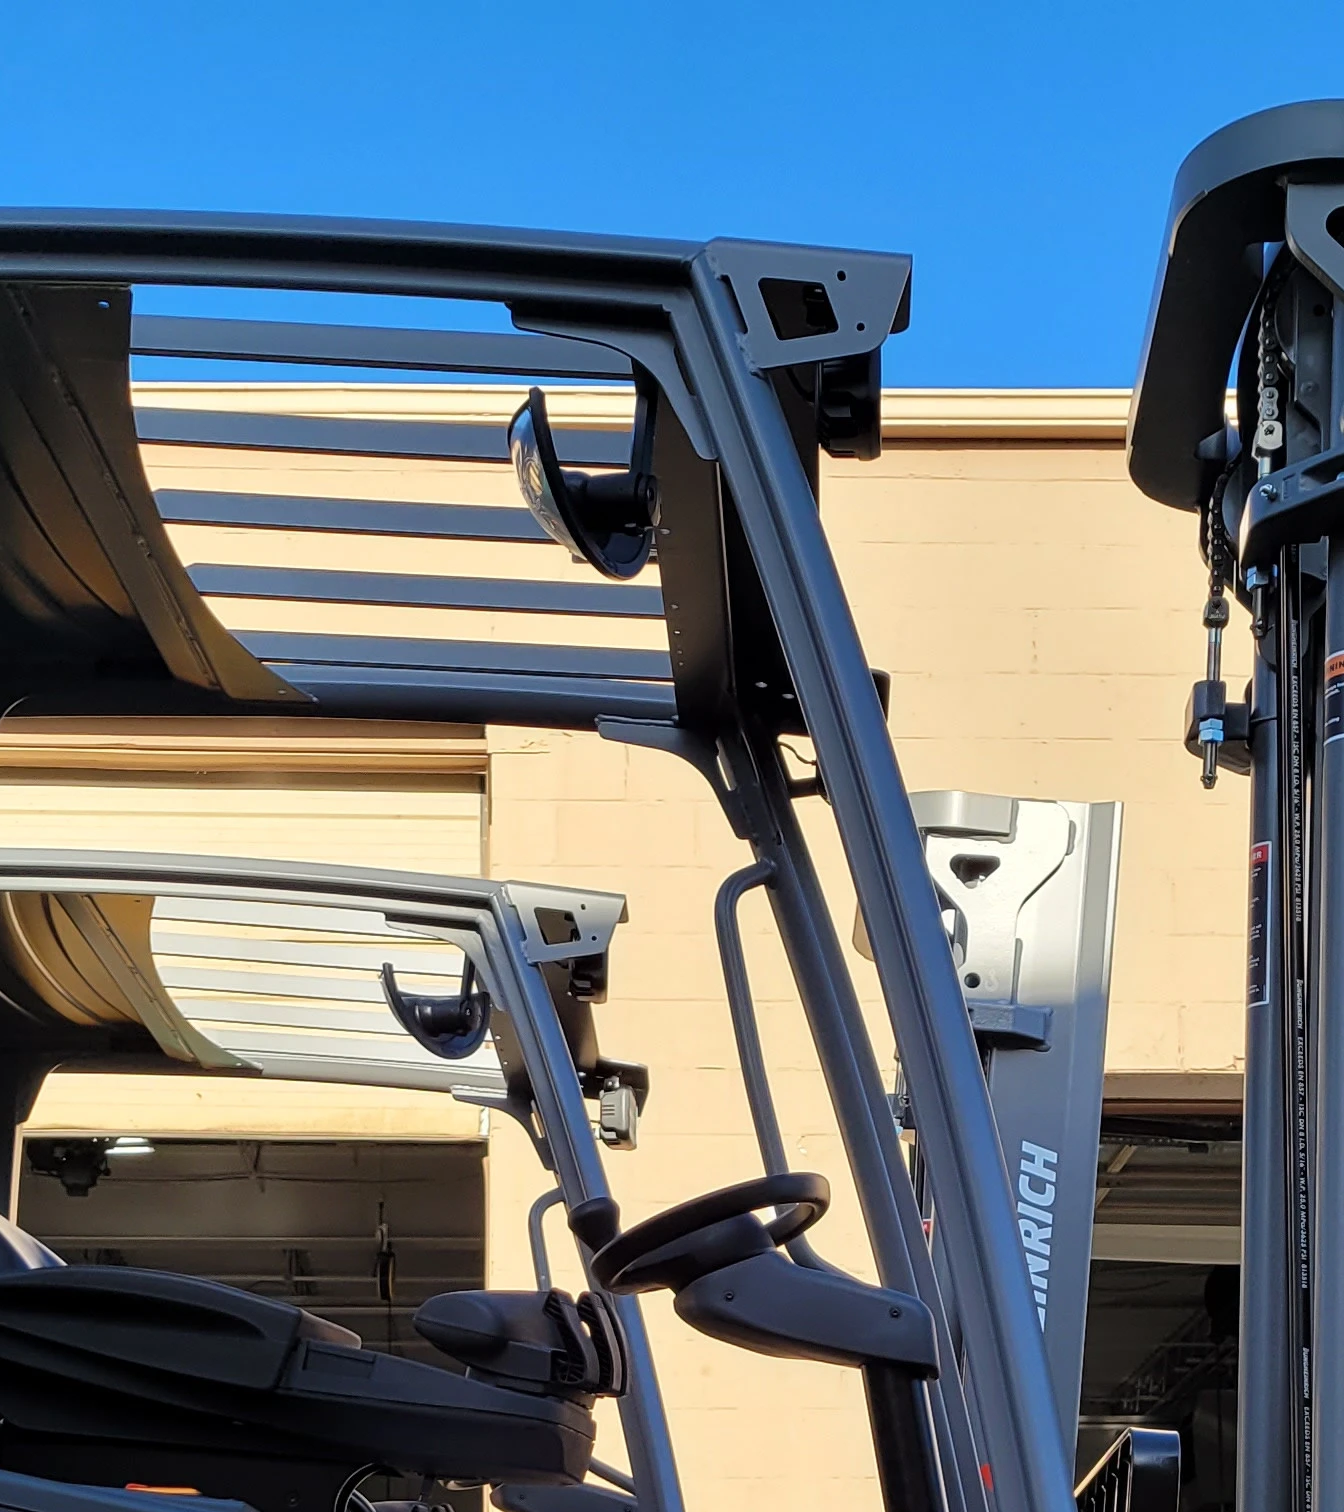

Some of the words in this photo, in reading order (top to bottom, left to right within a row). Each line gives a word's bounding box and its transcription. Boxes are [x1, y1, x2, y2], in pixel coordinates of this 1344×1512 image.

[1291, 676, 1299, 708] EXCEEDS
[1292, 709, 1299, 718] EN
[1292, 720, 1300, 733] 857
[1293, 756, 1300, 767] DN
[1298, 1070, 1305, 1080] EN
[1298, 1118, 1305, 1130] DN
[1303, 1406, 1311, 1439] EXCEEDS
